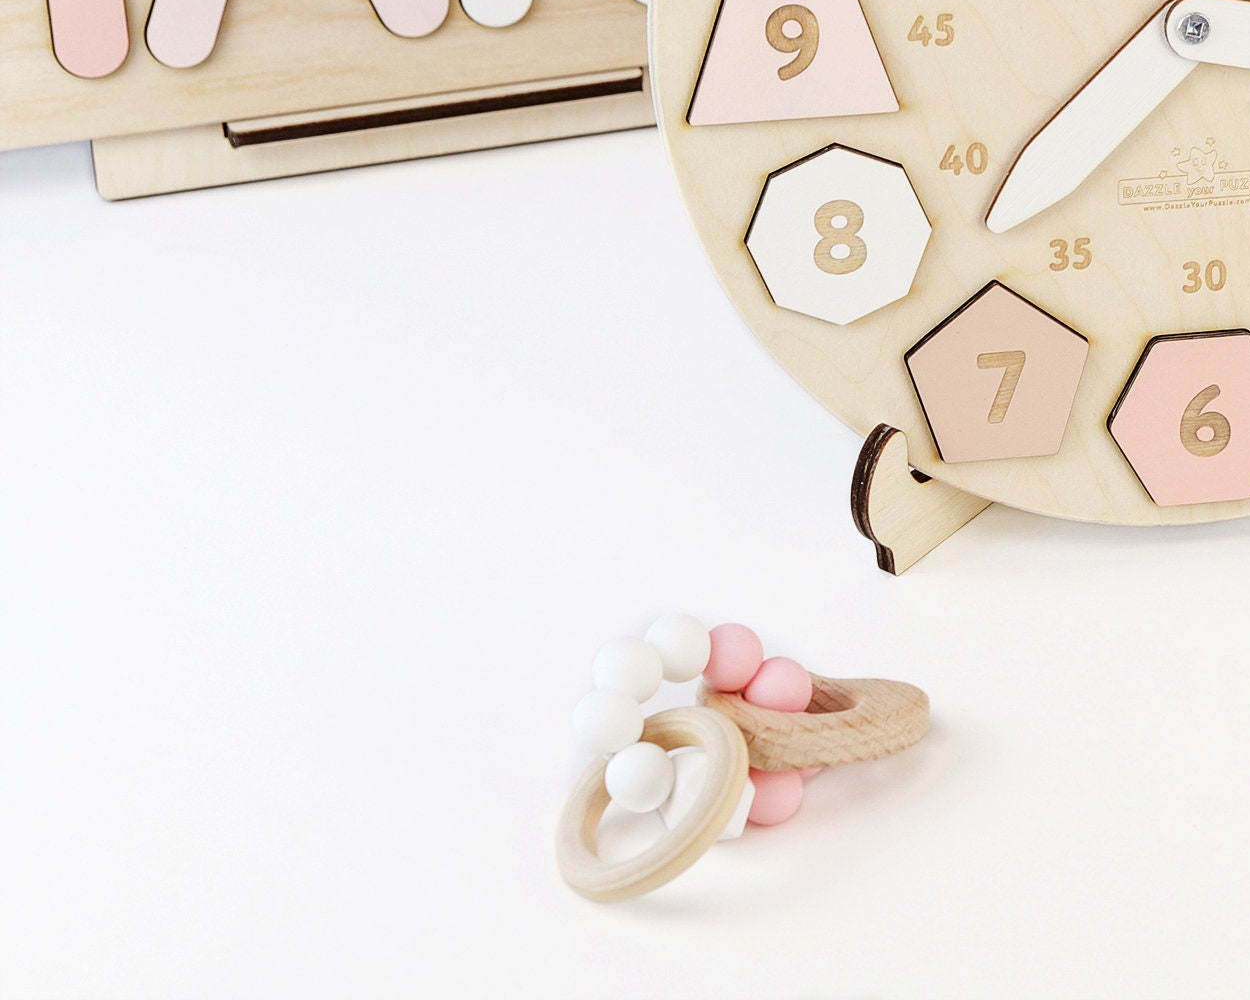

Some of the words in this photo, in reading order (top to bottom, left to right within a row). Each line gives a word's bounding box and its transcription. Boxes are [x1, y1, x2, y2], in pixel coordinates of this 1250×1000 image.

[765, 4, 819, 81] 9
[907, 13, 954, 47] 45
[939, 142, 988, 176] 40
[1122, 183, 1181, 199] DAZZLE
[1187, 186, 1215, 198] your
[814, 200, 867, 275] 8
[1049, 238, 1092, 271] 35
[1182, 260, 1226, 293] 30
[977, 350, 1026, 424] 7
[1180, 384, 1231, 457] 6
